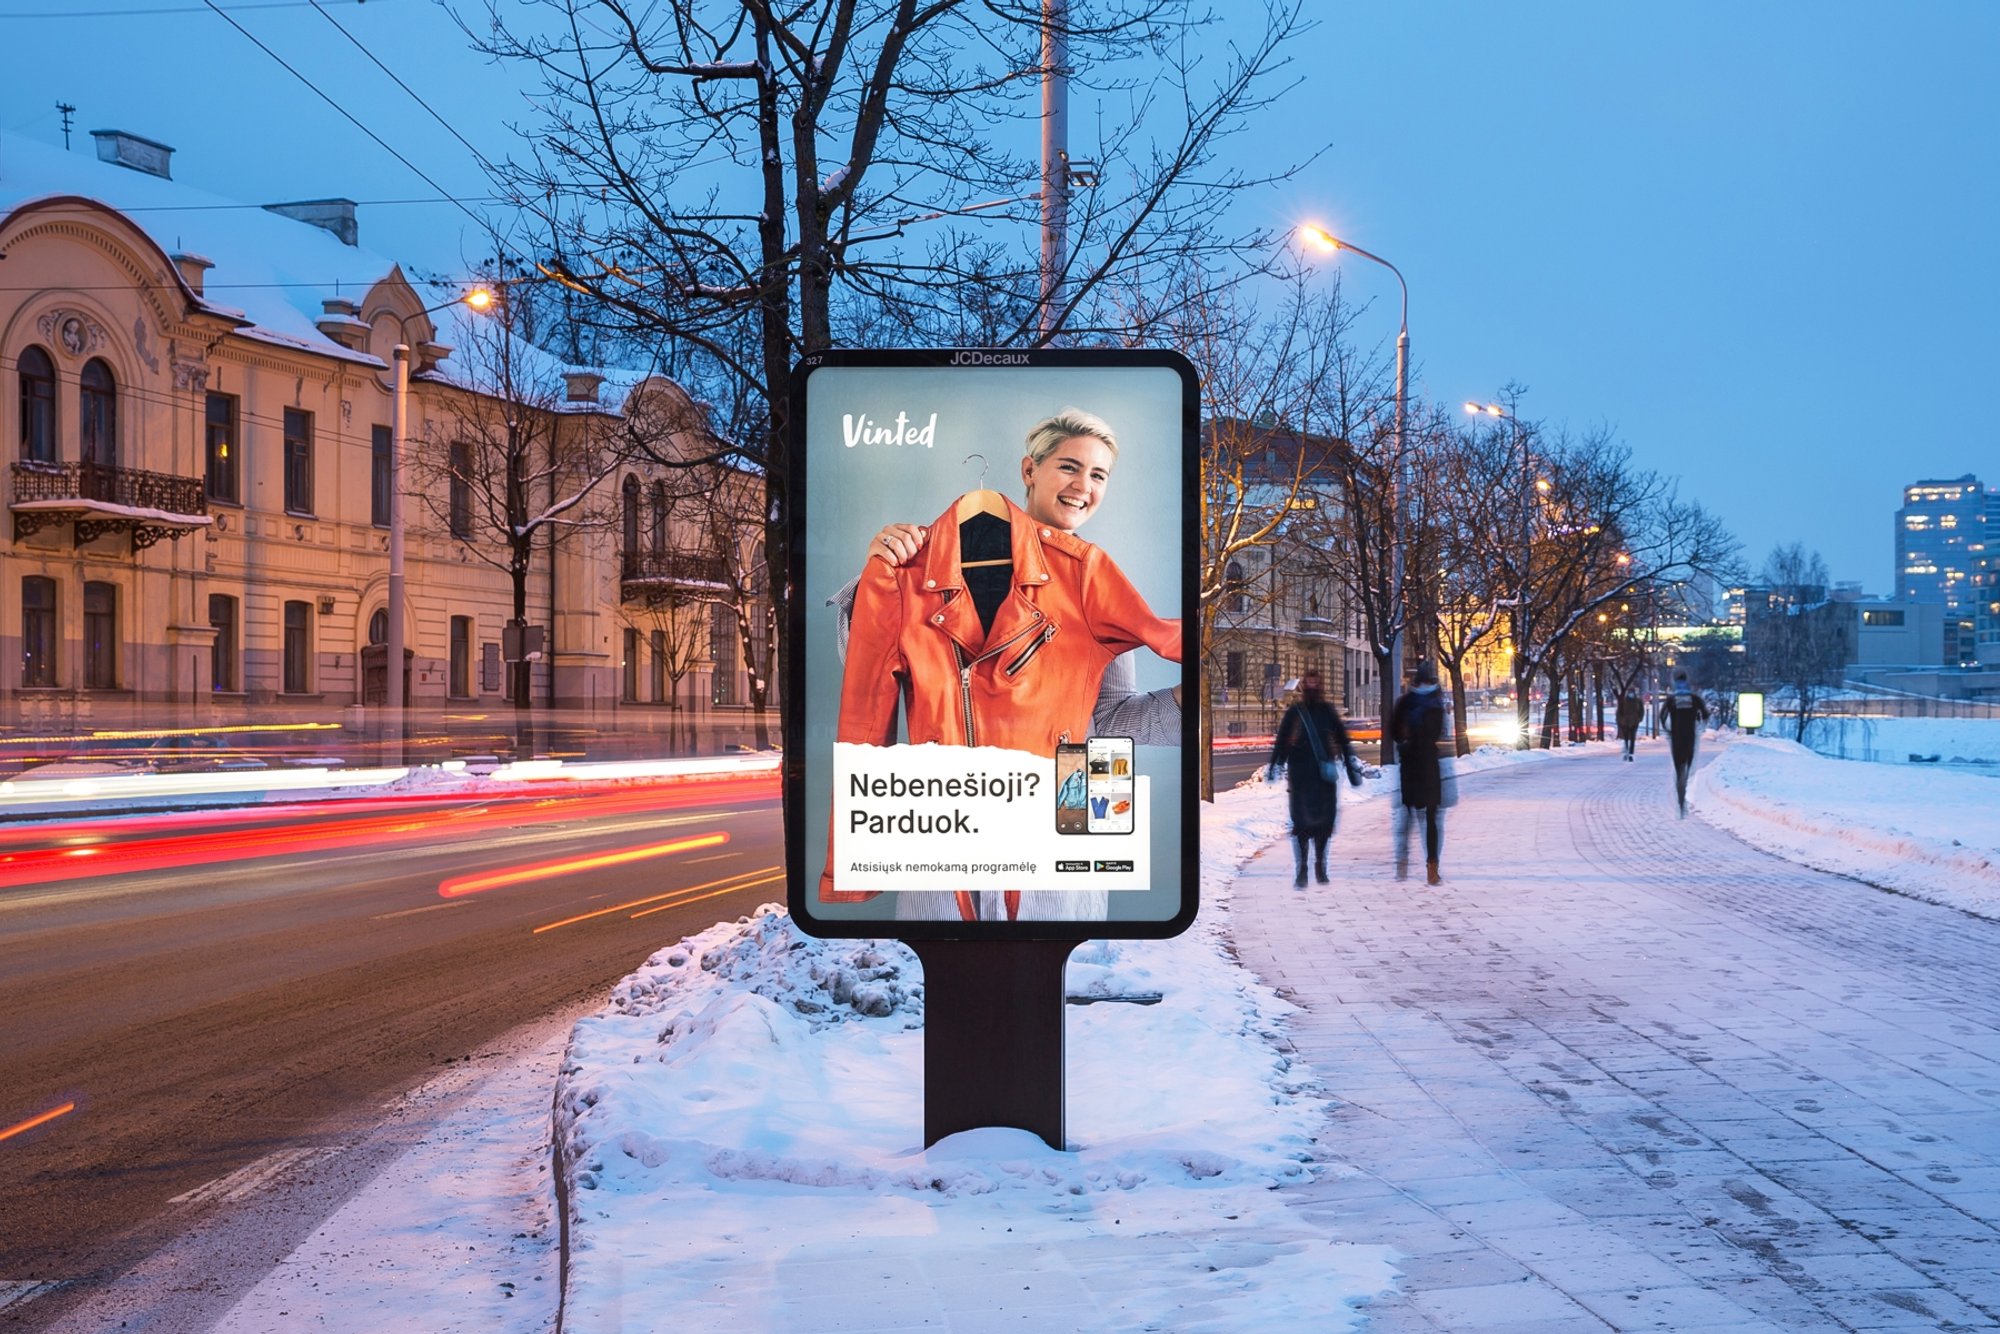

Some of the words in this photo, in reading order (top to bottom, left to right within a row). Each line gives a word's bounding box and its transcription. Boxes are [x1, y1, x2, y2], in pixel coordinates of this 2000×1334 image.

[806, 355, 823, 365] 327
[950, 351, 1030, 365] JCDecaux
[842, 411, 938, 449] Vinted
[850, 772, 1041, 803] Nebenešioji?
[850, 809, 979, 834] Parduok.
[850, 862, 902, 875] Atsisiųsk
[905, 862, 968, 874] nemokamą
[971, 862, 1037, 875] programėlę
